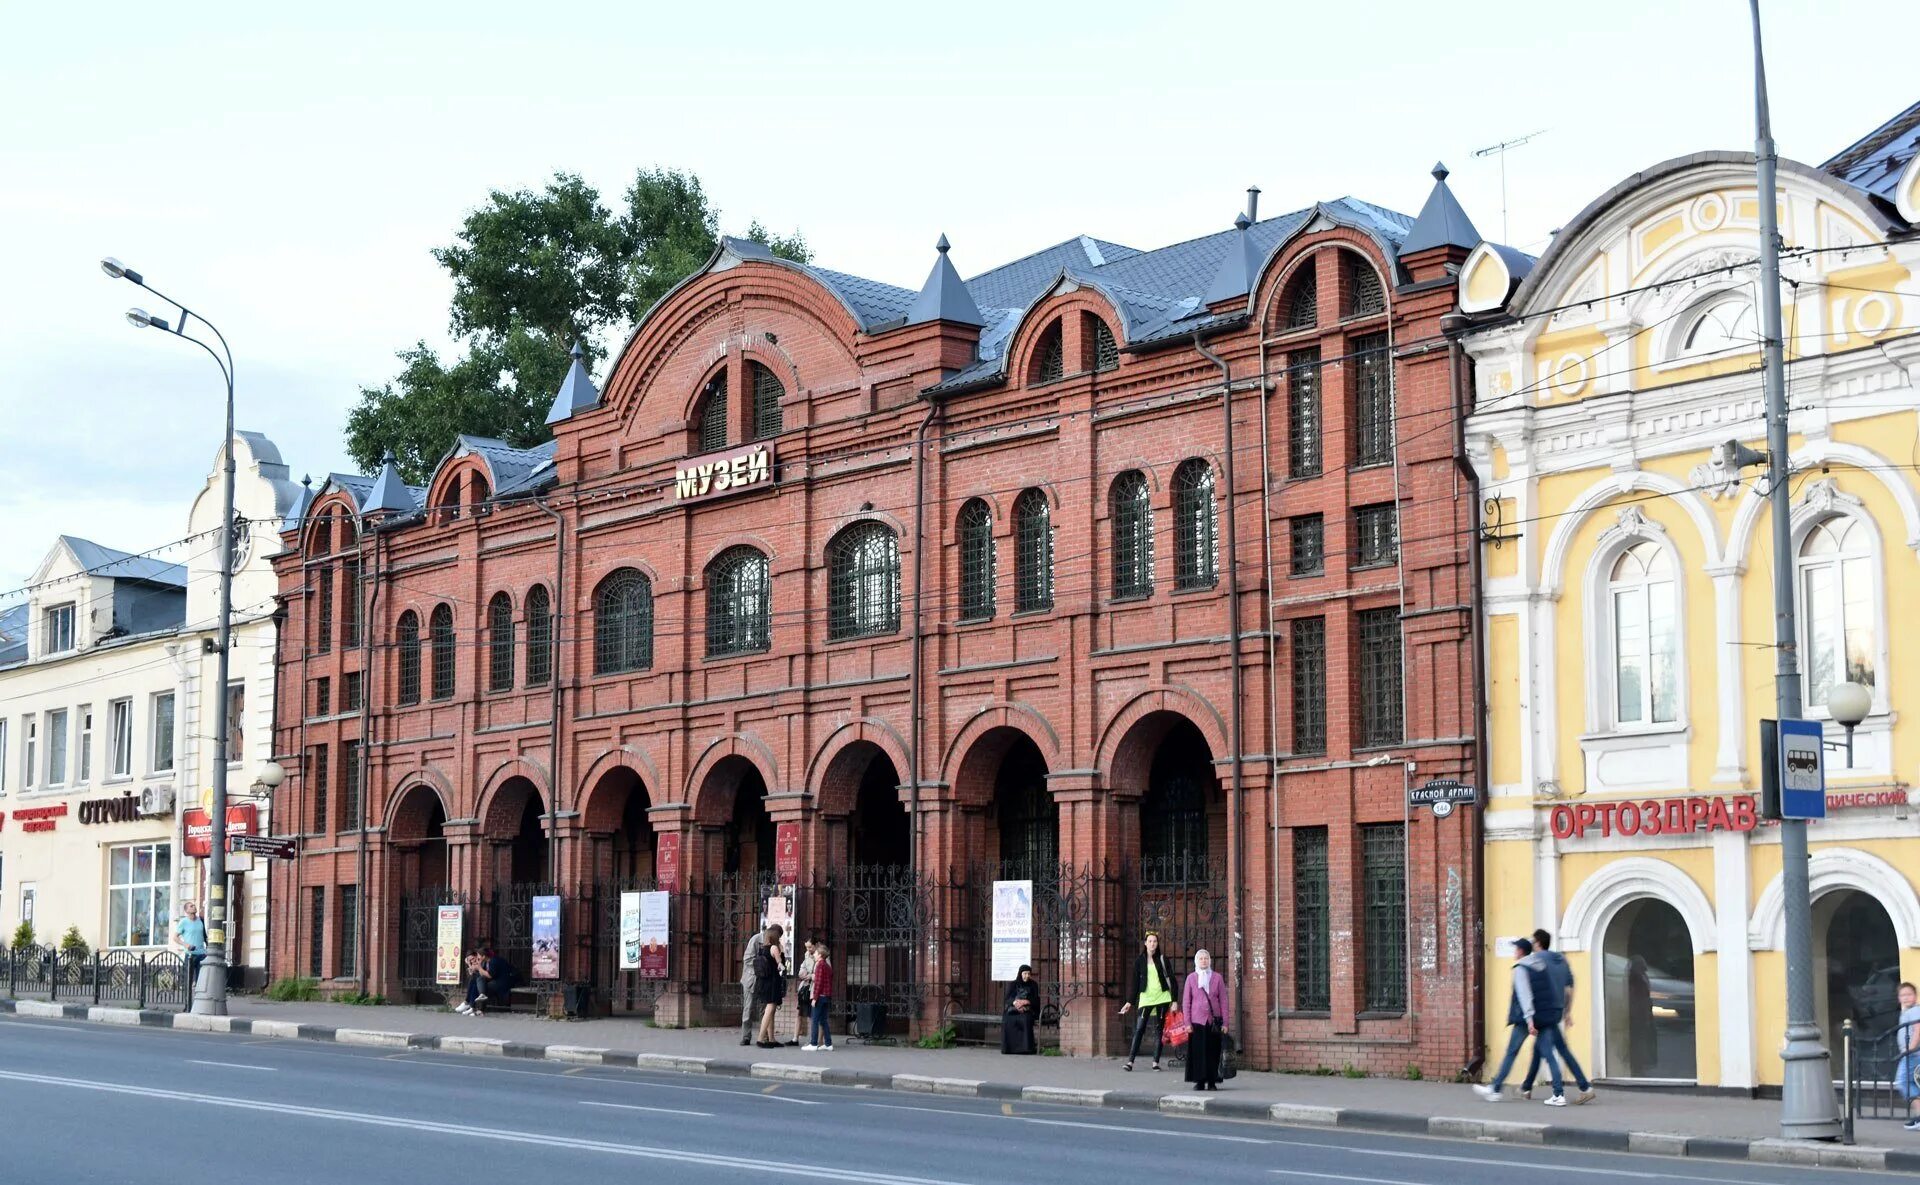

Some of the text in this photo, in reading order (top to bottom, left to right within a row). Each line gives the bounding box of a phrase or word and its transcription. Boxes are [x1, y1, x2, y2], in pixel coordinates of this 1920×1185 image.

[675, 445, 768, 500] МУЗЕЙ
[1411, 788, 1474, 800] КРАСНОЙ АРМИИ
[1826, 788, 1907, 809] ДИЧЕСКИЙ
[1550, 796, 1757, 839] ОРТОЗДРАВ
